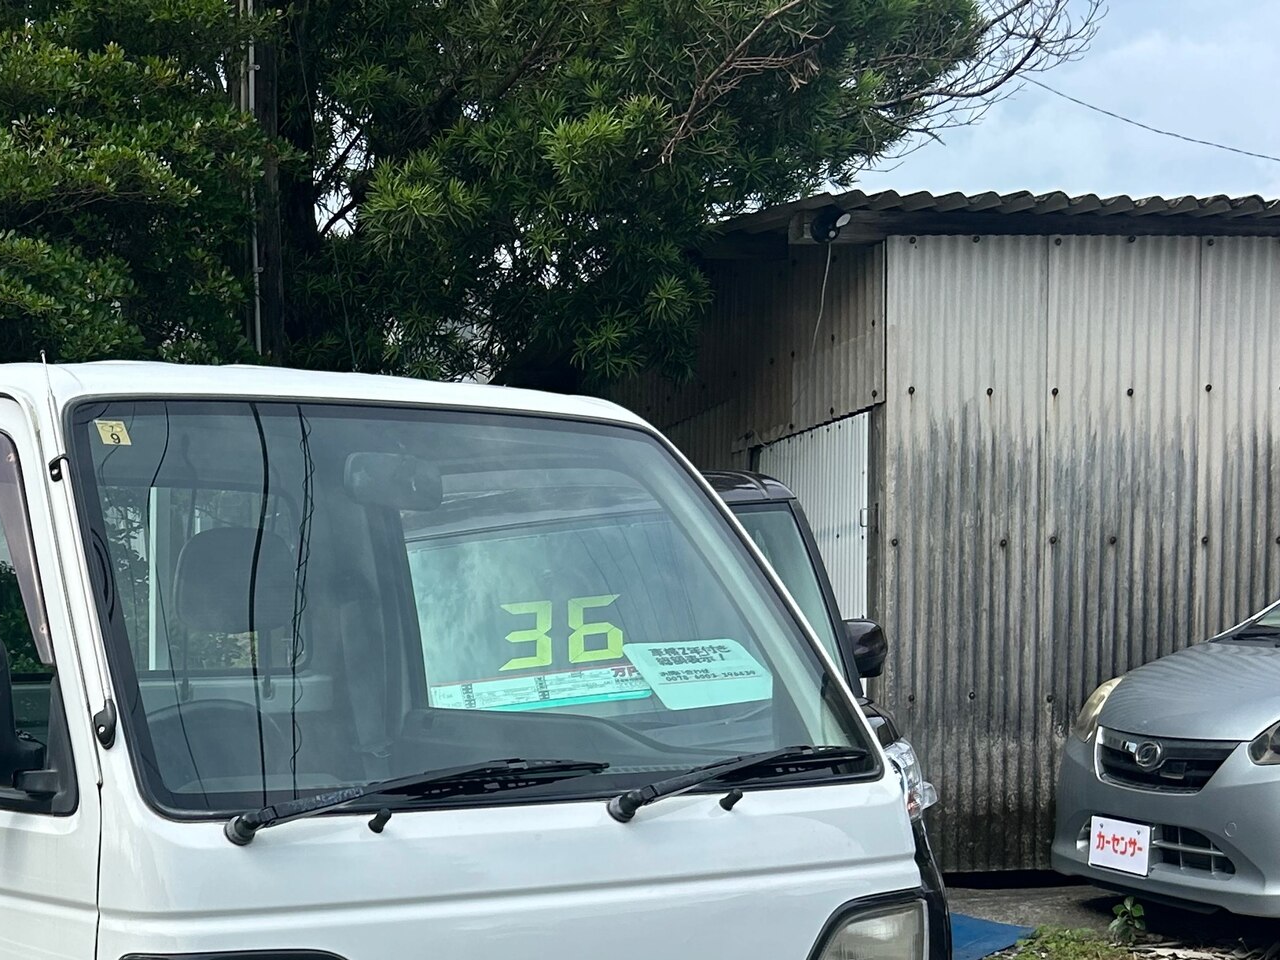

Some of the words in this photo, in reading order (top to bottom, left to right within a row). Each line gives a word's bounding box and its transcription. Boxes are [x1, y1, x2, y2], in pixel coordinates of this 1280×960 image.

[111, 433, 121, 444] 9
[498, 594, 624, 671] 36
[1096, 832, 1143, 857] カーセンサー
